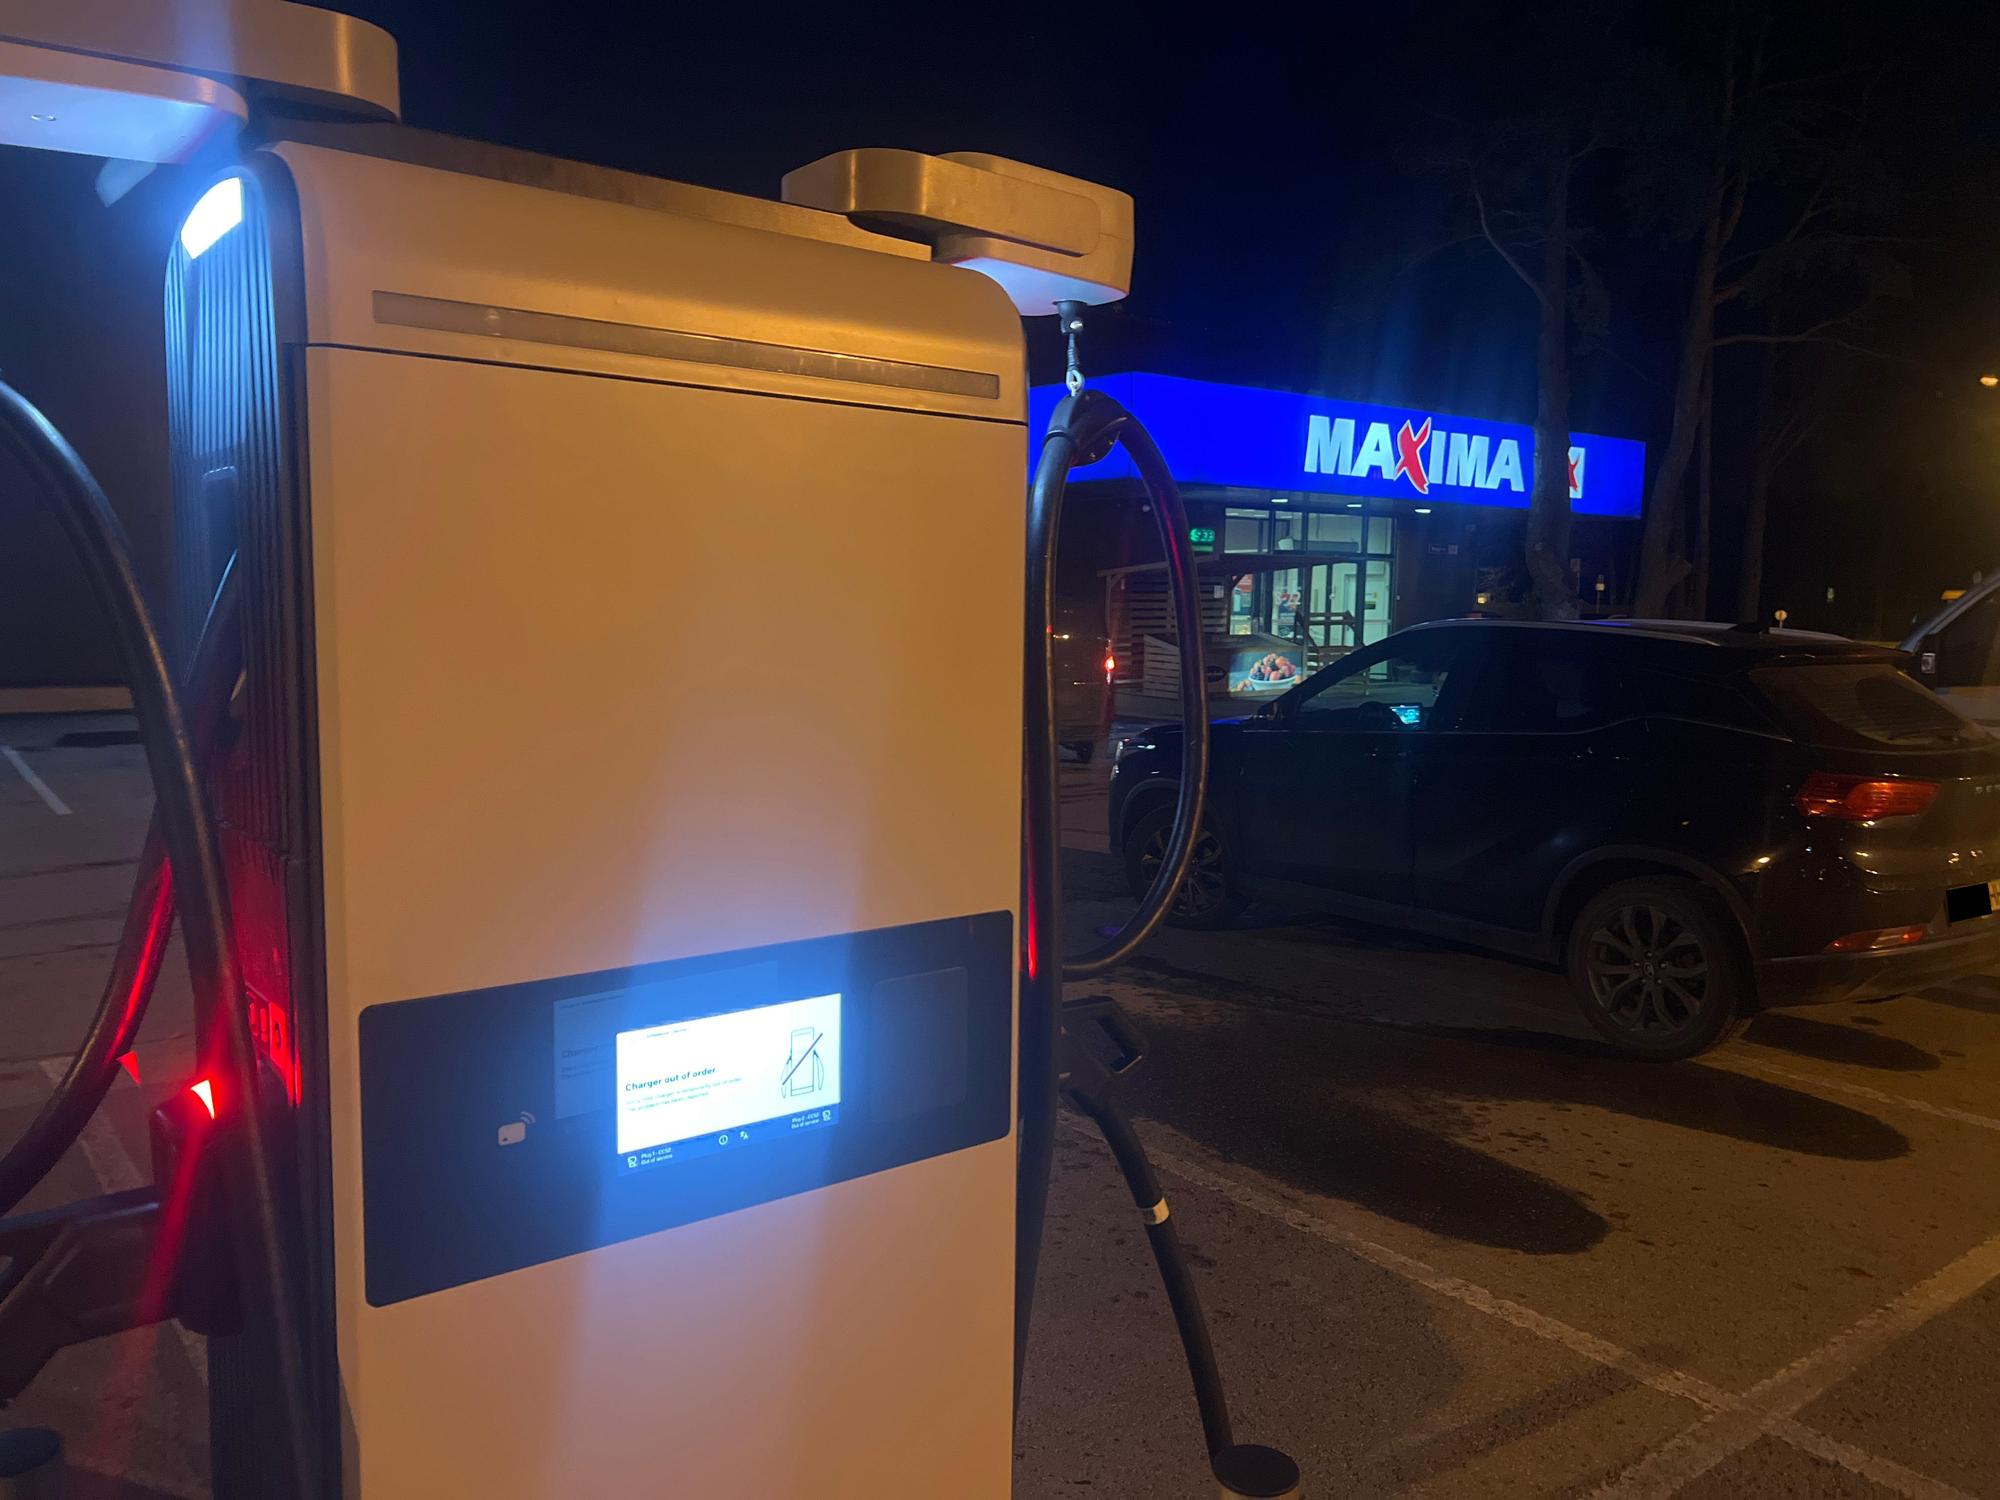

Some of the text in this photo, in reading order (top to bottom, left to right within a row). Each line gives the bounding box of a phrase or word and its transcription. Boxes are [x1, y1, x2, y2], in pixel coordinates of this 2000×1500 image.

[1304, 414, 1525, 494] MAXIMA
[625, 1067, 716, 1091] Charger out of order
